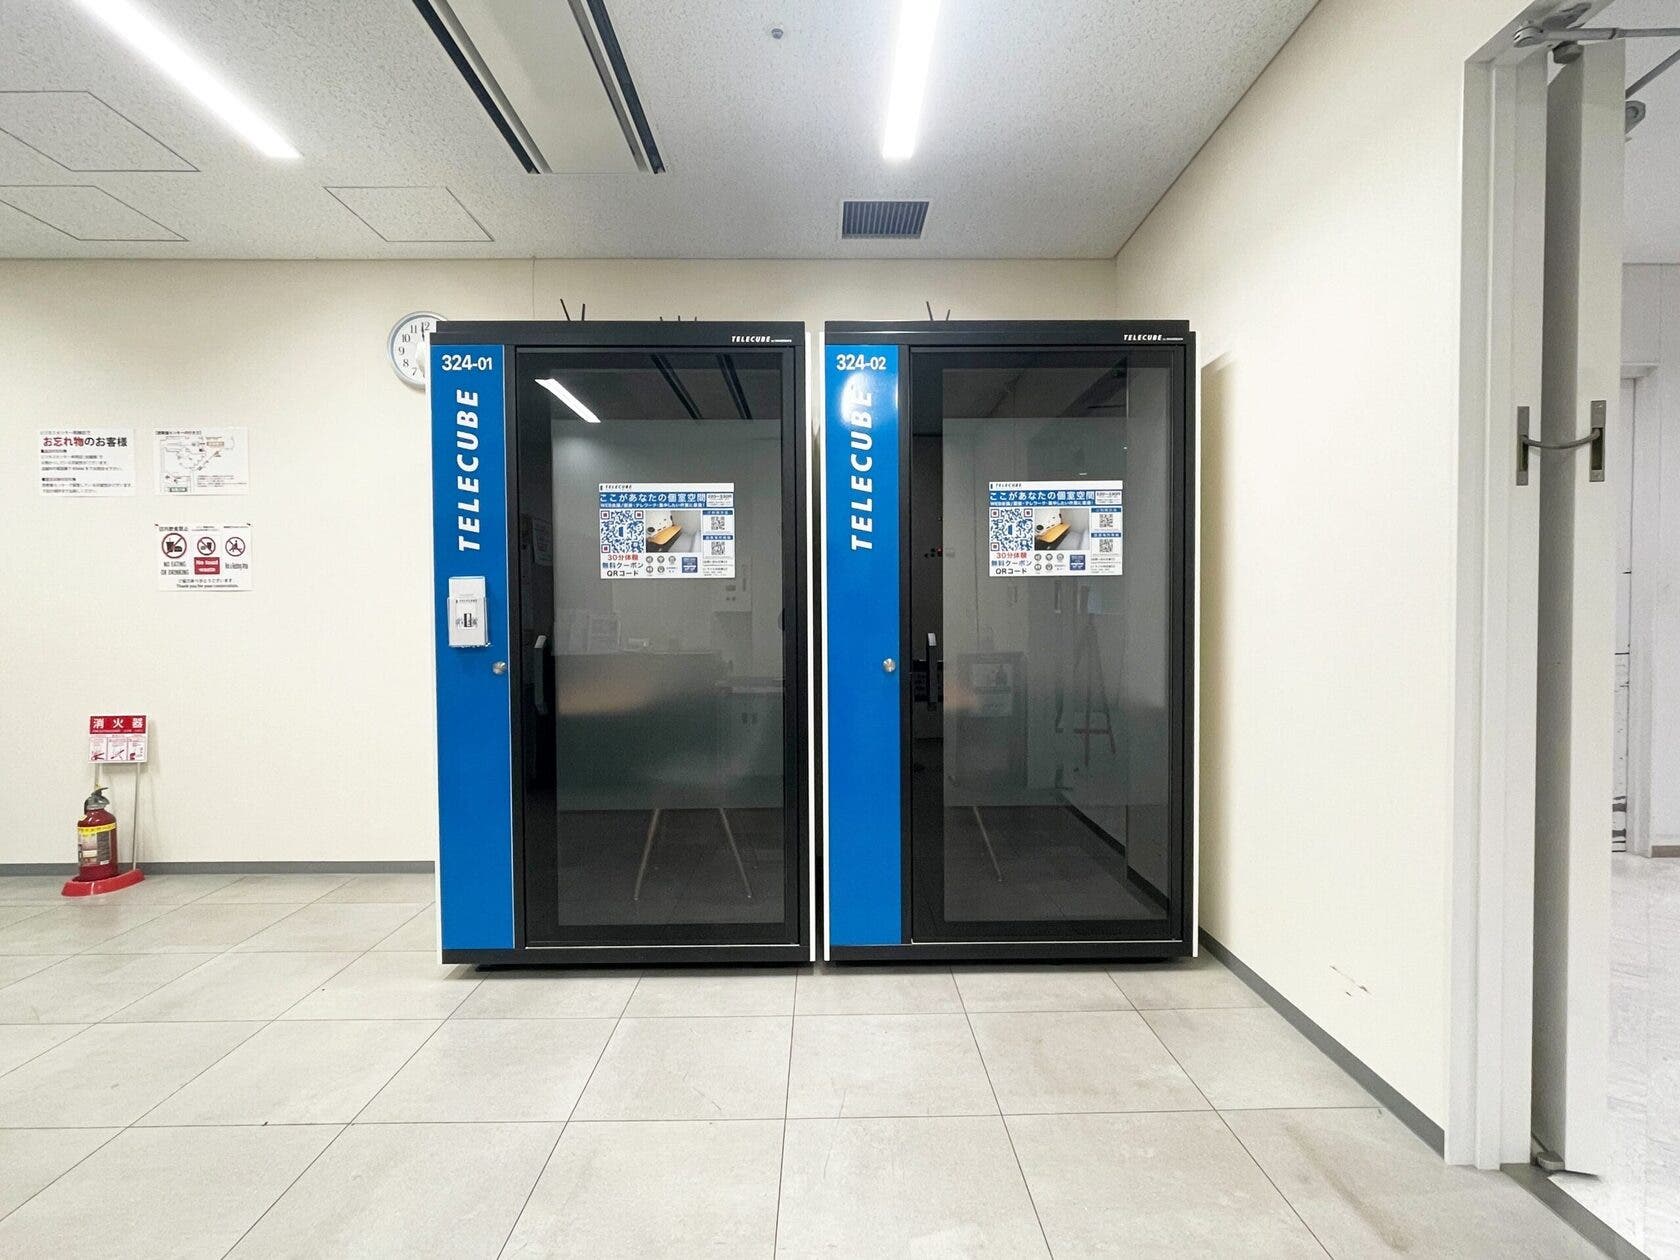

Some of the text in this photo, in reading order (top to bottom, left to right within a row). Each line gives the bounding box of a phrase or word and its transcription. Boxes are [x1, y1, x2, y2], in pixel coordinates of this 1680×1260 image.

[410, 324, 417, 333] 11
[401, 334, 411, 343] 10
[731, 335, 771, 343] TELECUBE
[398, 346, 405, 355] 9
[402, 359, 409, 367] 8
[441, 354, 493, 371] 324-01
[836, 354, 887, 371] 324-02
[411, 367, 418, 376] 7
[43, 436, 128, 447] お忘れ物のお客様
[456, 389, 480, 551] TELECUBE
[850, 388, 873, 551] TELECUBE
[599, 493, 705, 503] ここがあなたの個室空間
[989, 491, 1094, 501] ここがあなたの個室空間
[607, 553, 639, 561] 30分体験
[92, 717, 143, 729] 消火器
